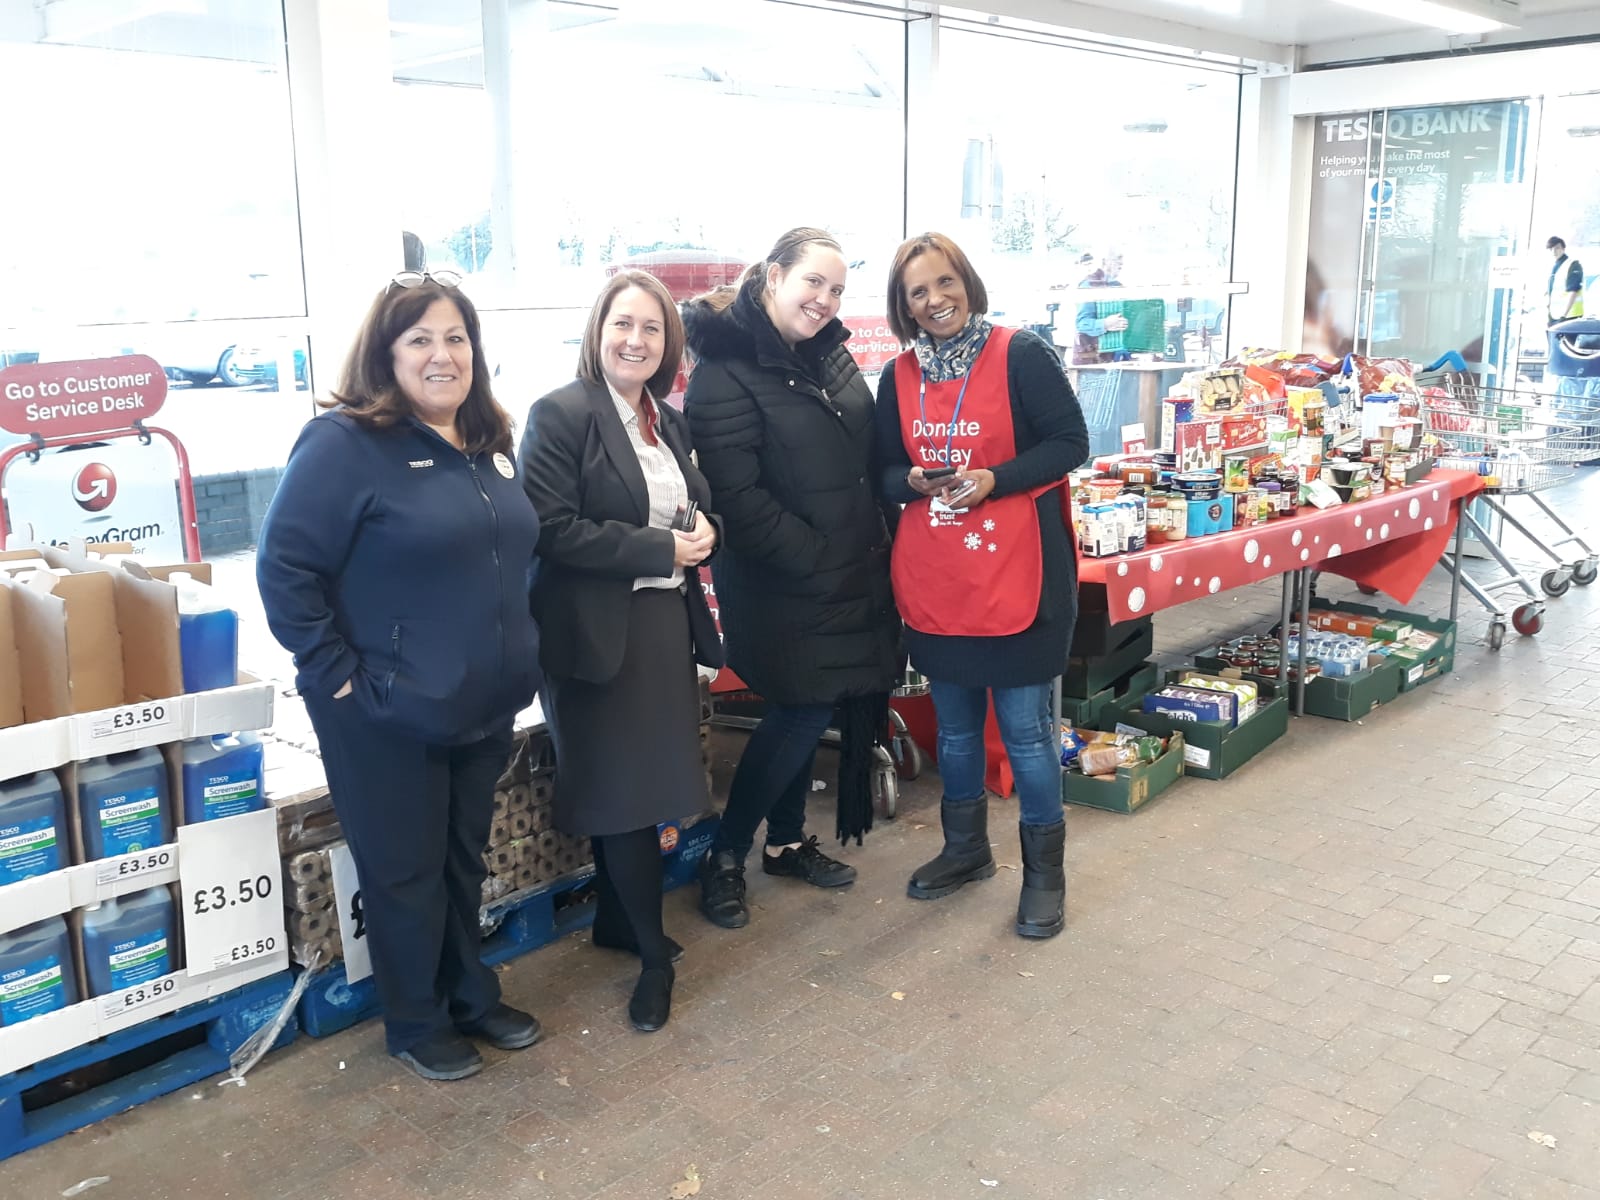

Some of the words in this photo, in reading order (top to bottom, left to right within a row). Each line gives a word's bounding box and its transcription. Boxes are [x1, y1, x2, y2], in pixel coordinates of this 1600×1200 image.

[1411, 109, 1491, 137] BANK
[1320, 155, 1356, 167] Helping
[1405, 150, 1422, 161] the
[1424, 149, 1451, 160] most
[1319, 168, 1330, 178] of
[1330, 169, 1353, 179] your
[1387, 165, 1416, 176] every
[1416, 162, 1436, 174] day
[858, 327, 873, 338] to
[848, 342, 897, 354] Service
[5, 383, 35, 401] Go
[39, 381, 60, 397] to
[64, 372, 152, 394] Customer
[26, 398, 99, 422] Service
[102, 392, 145, 413] Desk
[912, 419, 981, 438] Donate
[919, 446, 973, 467] today
[113, 706, 164, 728] £3.50
[208, 783, 251, 796] Screenwash
[105, 802, 152, 818] Screenwash
[119, 852, 169, 875] £3.50
[193, 874, 272, 915] £3.50
[114, 943, 160, 962] Screenwash
[231, 937, 276, 961] £3.50
[3, 971, 53, 993] Screenwash
[124, 979, 174, 1006] £3.50
